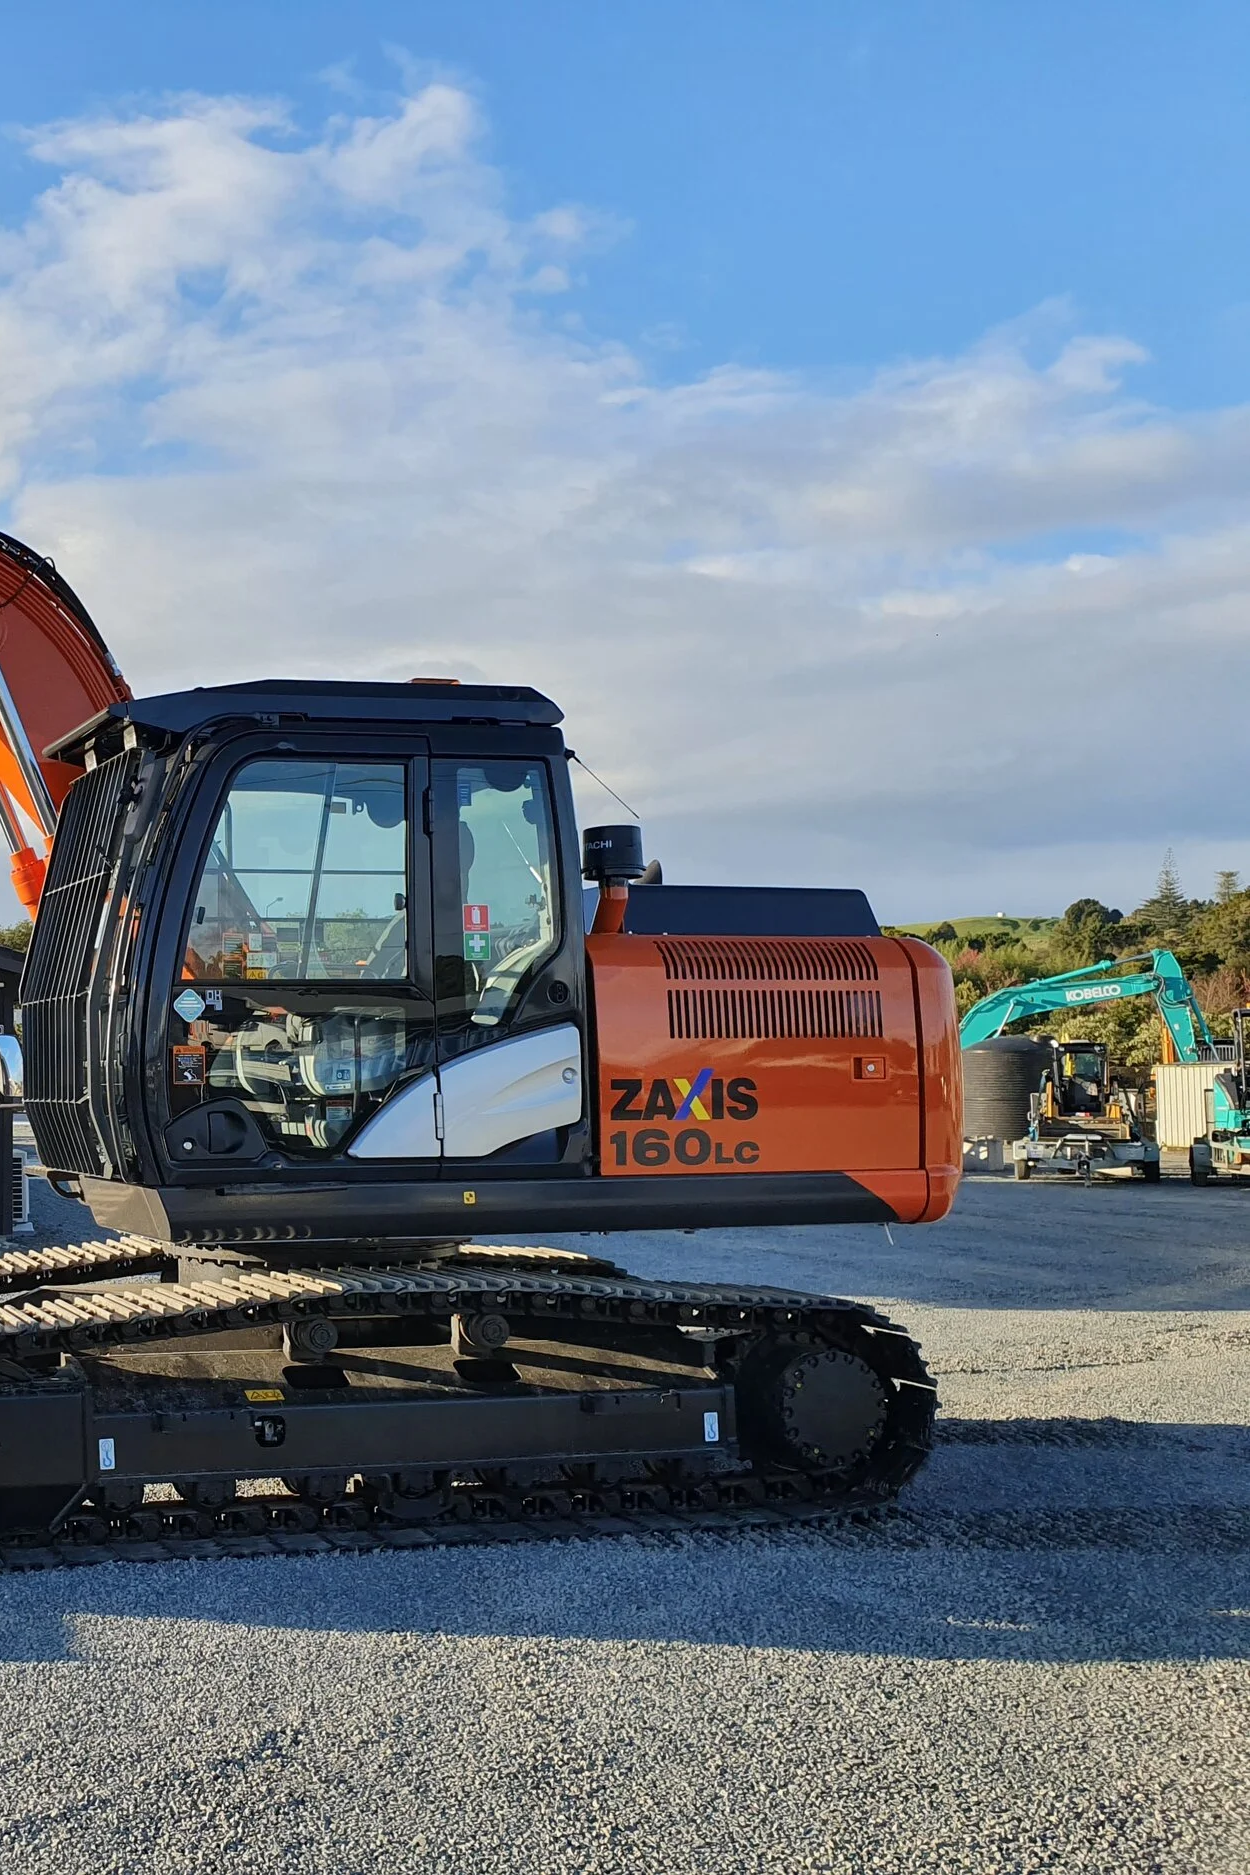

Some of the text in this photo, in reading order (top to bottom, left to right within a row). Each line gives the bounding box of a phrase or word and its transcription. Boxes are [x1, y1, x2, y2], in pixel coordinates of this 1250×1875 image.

[584, 839, 613, 850] TACHI
[1065, 984, 1121, 1002] KOBELCO
[610, 1068, 759, 1121] ZAXIS
